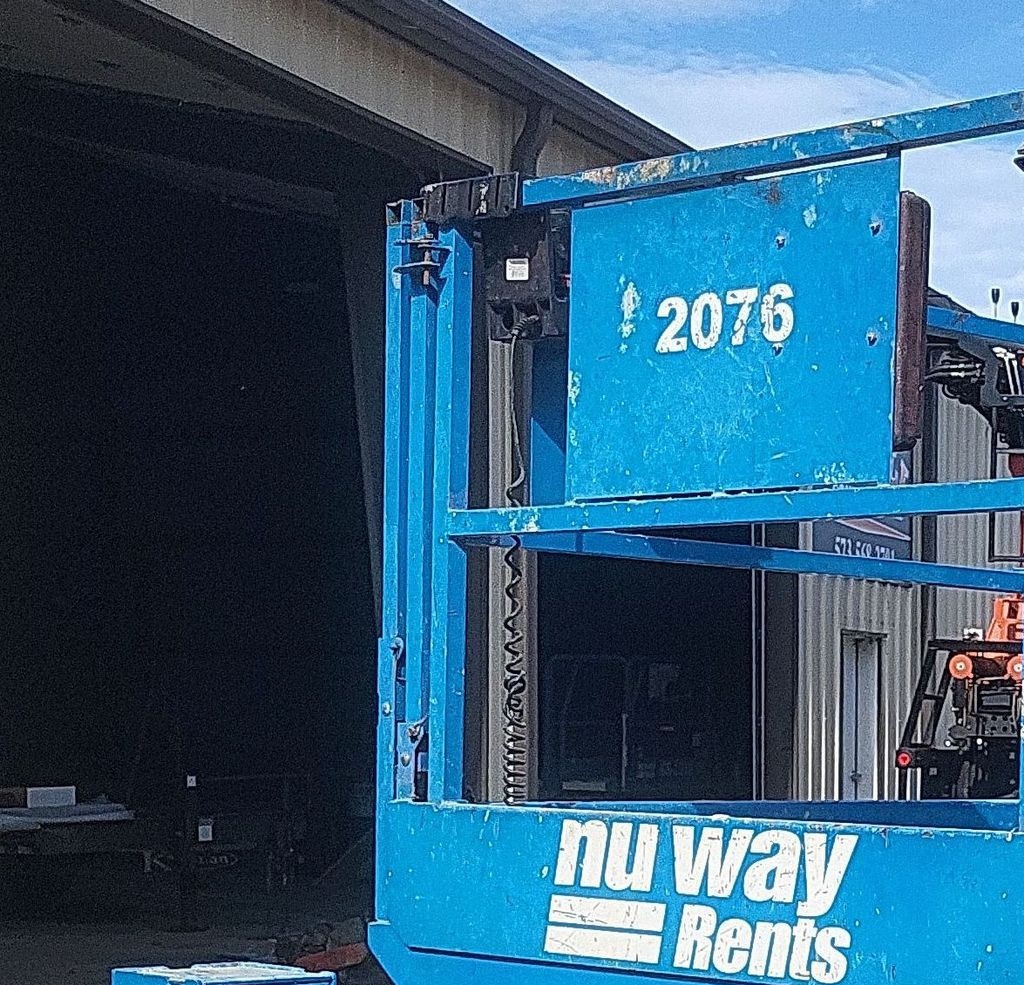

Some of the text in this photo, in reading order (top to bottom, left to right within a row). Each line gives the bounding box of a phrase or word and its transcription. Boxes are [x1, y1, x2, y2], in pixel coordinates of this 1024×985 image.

[656, 283, 794, 353] 2076
[554, 819, 859, 917] nu way
[673, 903, 851, 984] Rents
